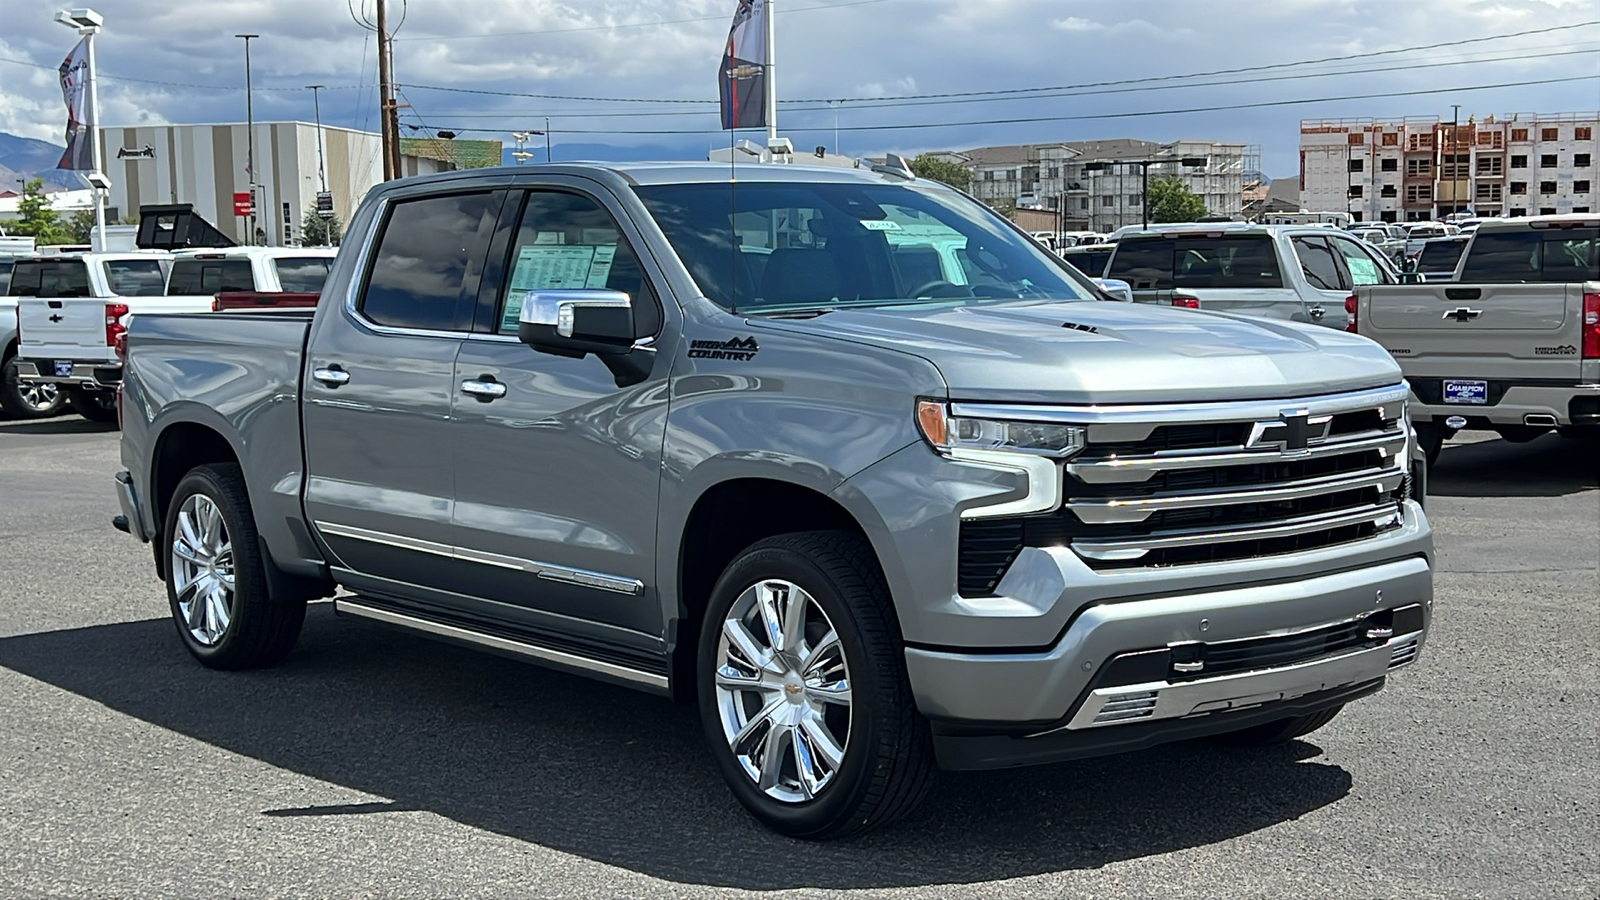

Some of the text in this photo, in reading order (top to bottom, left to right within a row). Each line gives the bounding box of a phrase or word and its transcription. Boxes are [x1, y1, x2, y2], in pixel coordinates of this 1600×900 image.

[690, 340, 725, 349] HIGH
[687, 349, 757, 361] COUNTRY
[1447, 383, 1485, 392] CHAMPION
